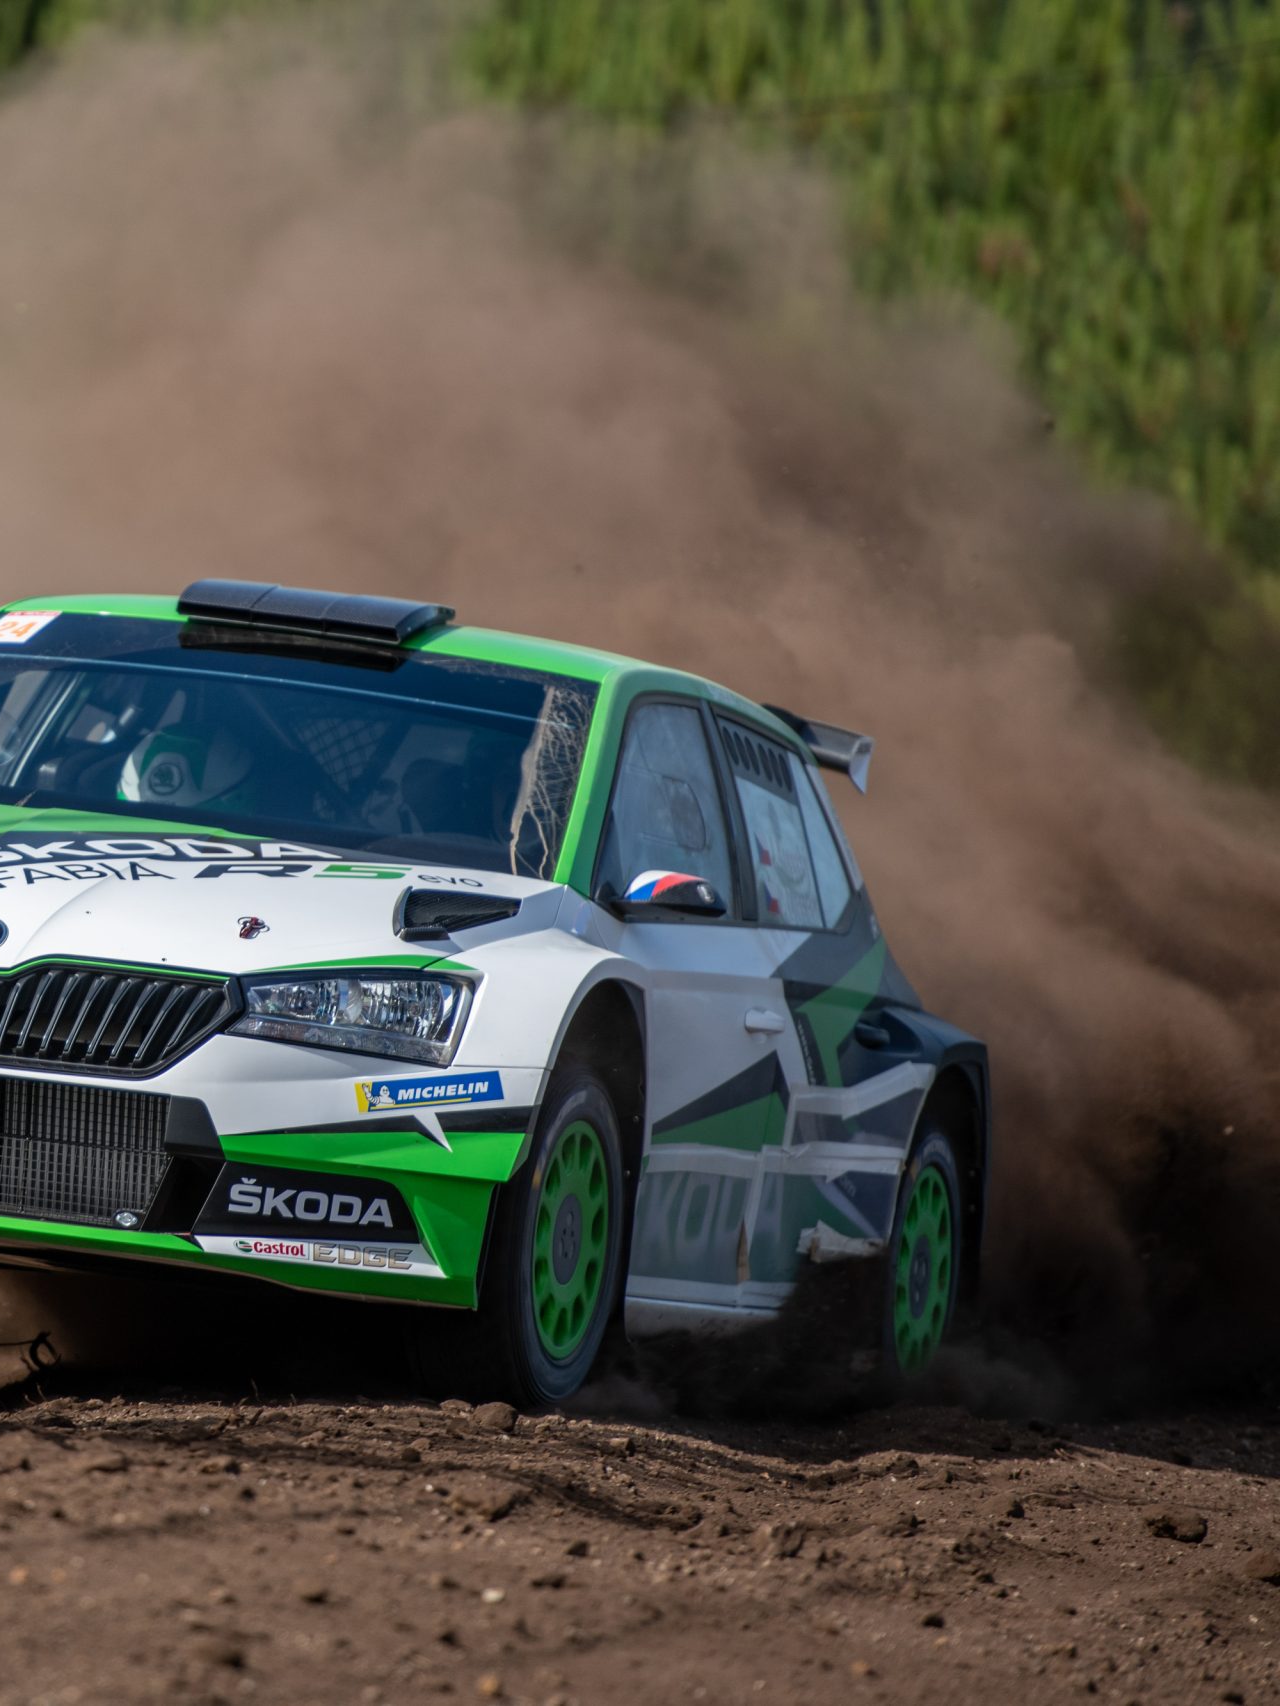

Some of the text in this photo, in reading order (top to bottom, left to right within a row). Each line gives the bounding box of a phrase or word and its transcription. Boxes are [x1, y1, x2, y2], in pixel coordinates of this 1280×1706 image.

[193, 862, 413, 880] R5
[417, 873, 483, 888] evo
[397, 1080, 489, 1101] MICHELIN
[228, 1176, 394, 1229] ŠKODA
[253, 1240, 414, 1270] Castrol EDGE
